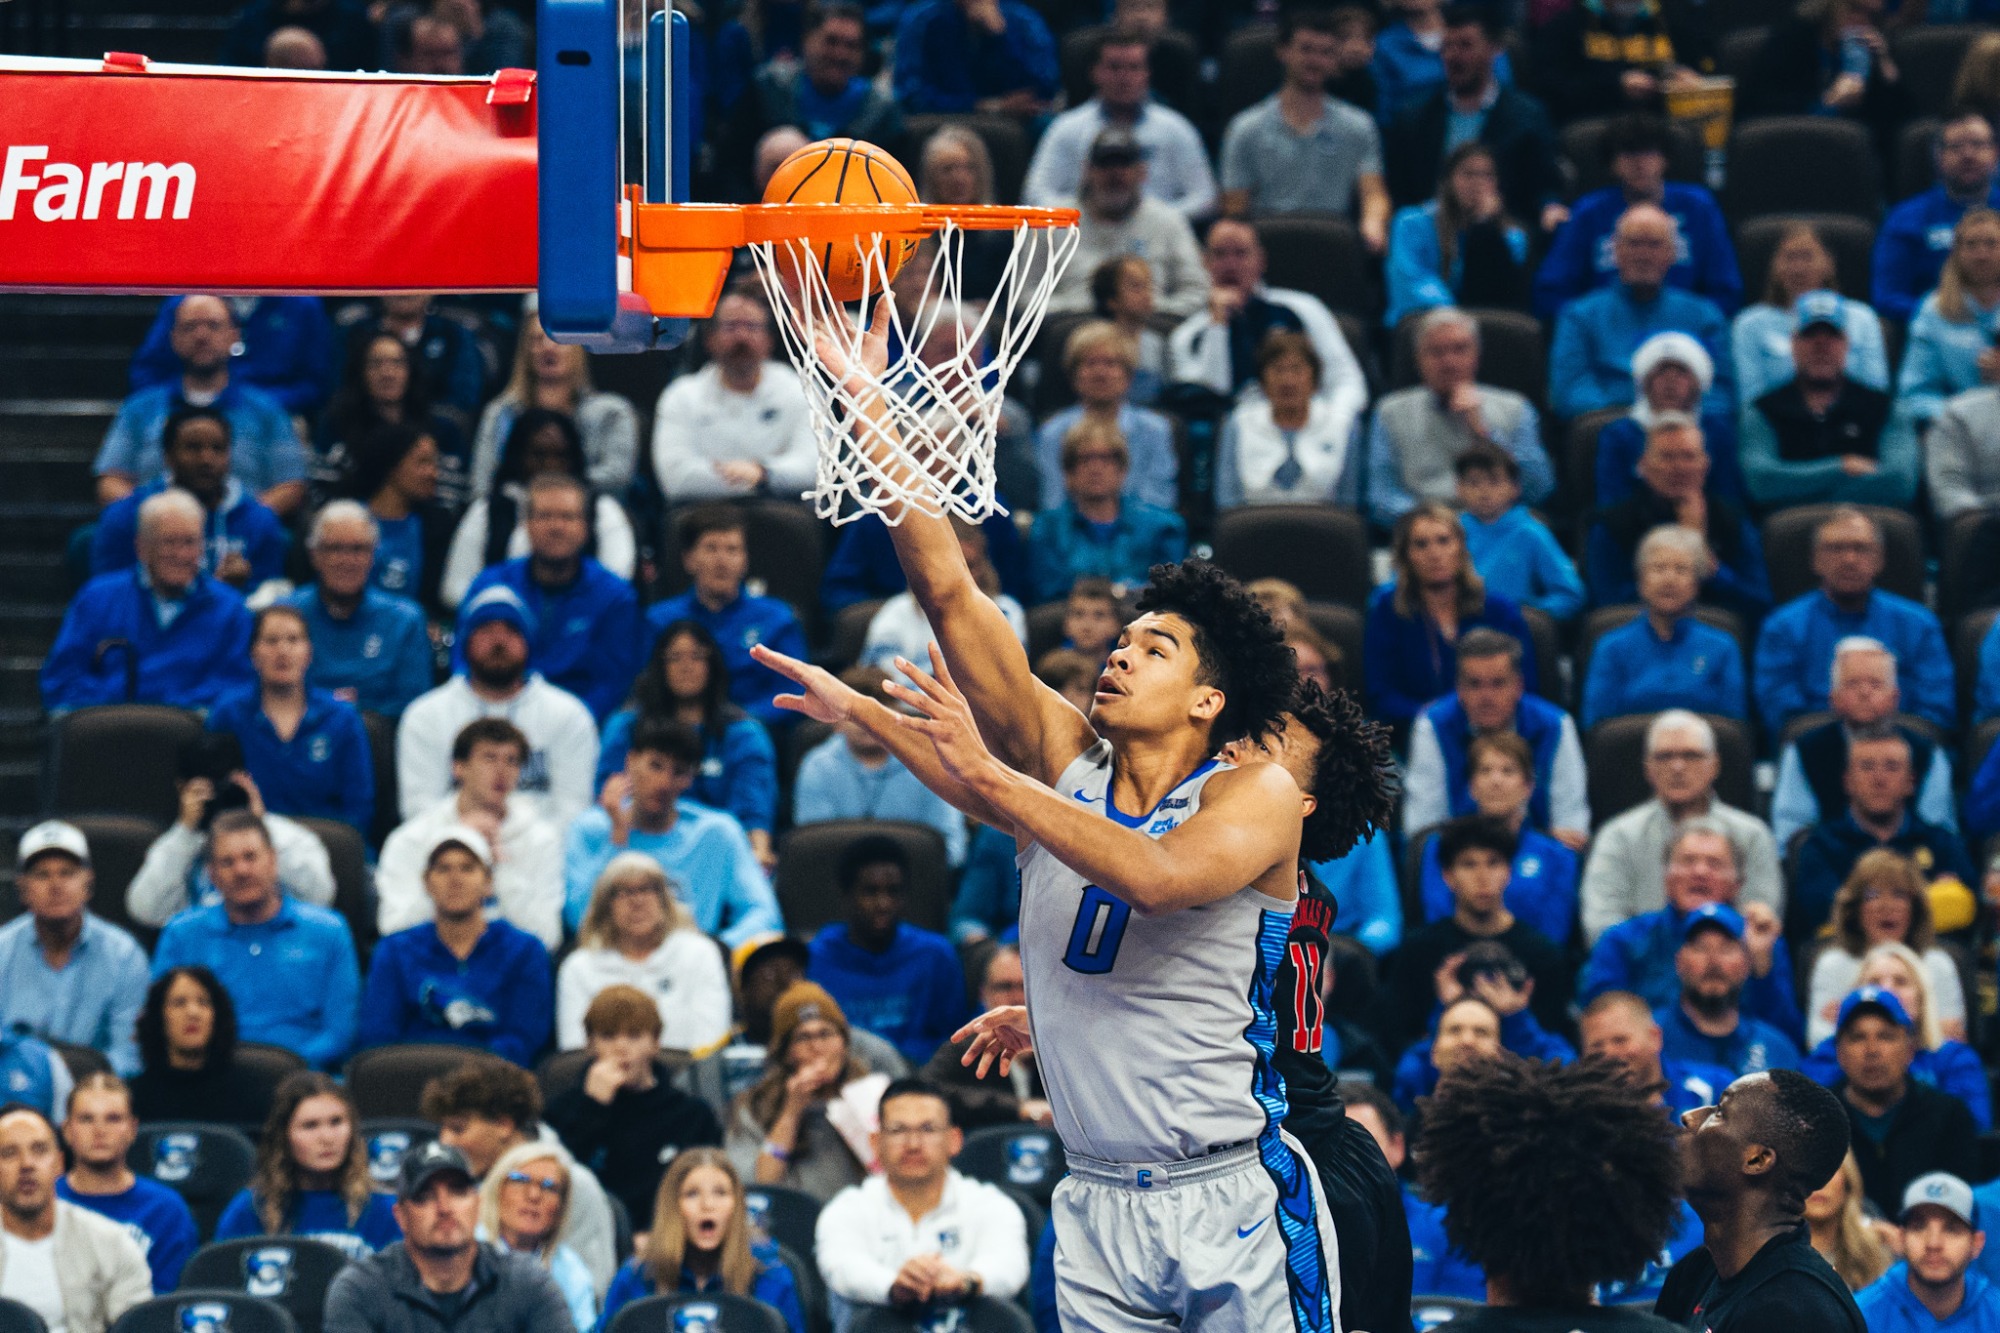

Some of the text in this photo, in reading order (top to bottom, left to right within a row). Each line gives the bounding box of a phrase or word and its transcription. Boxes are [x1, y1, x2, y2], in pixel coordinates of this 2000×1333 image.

[0, 145, 197, 222] Farm
[1062, 884, 1132, 974] 0
[1289, 942, 1324, 1053] 11
[1137, 1169, 1152, 1188] C
